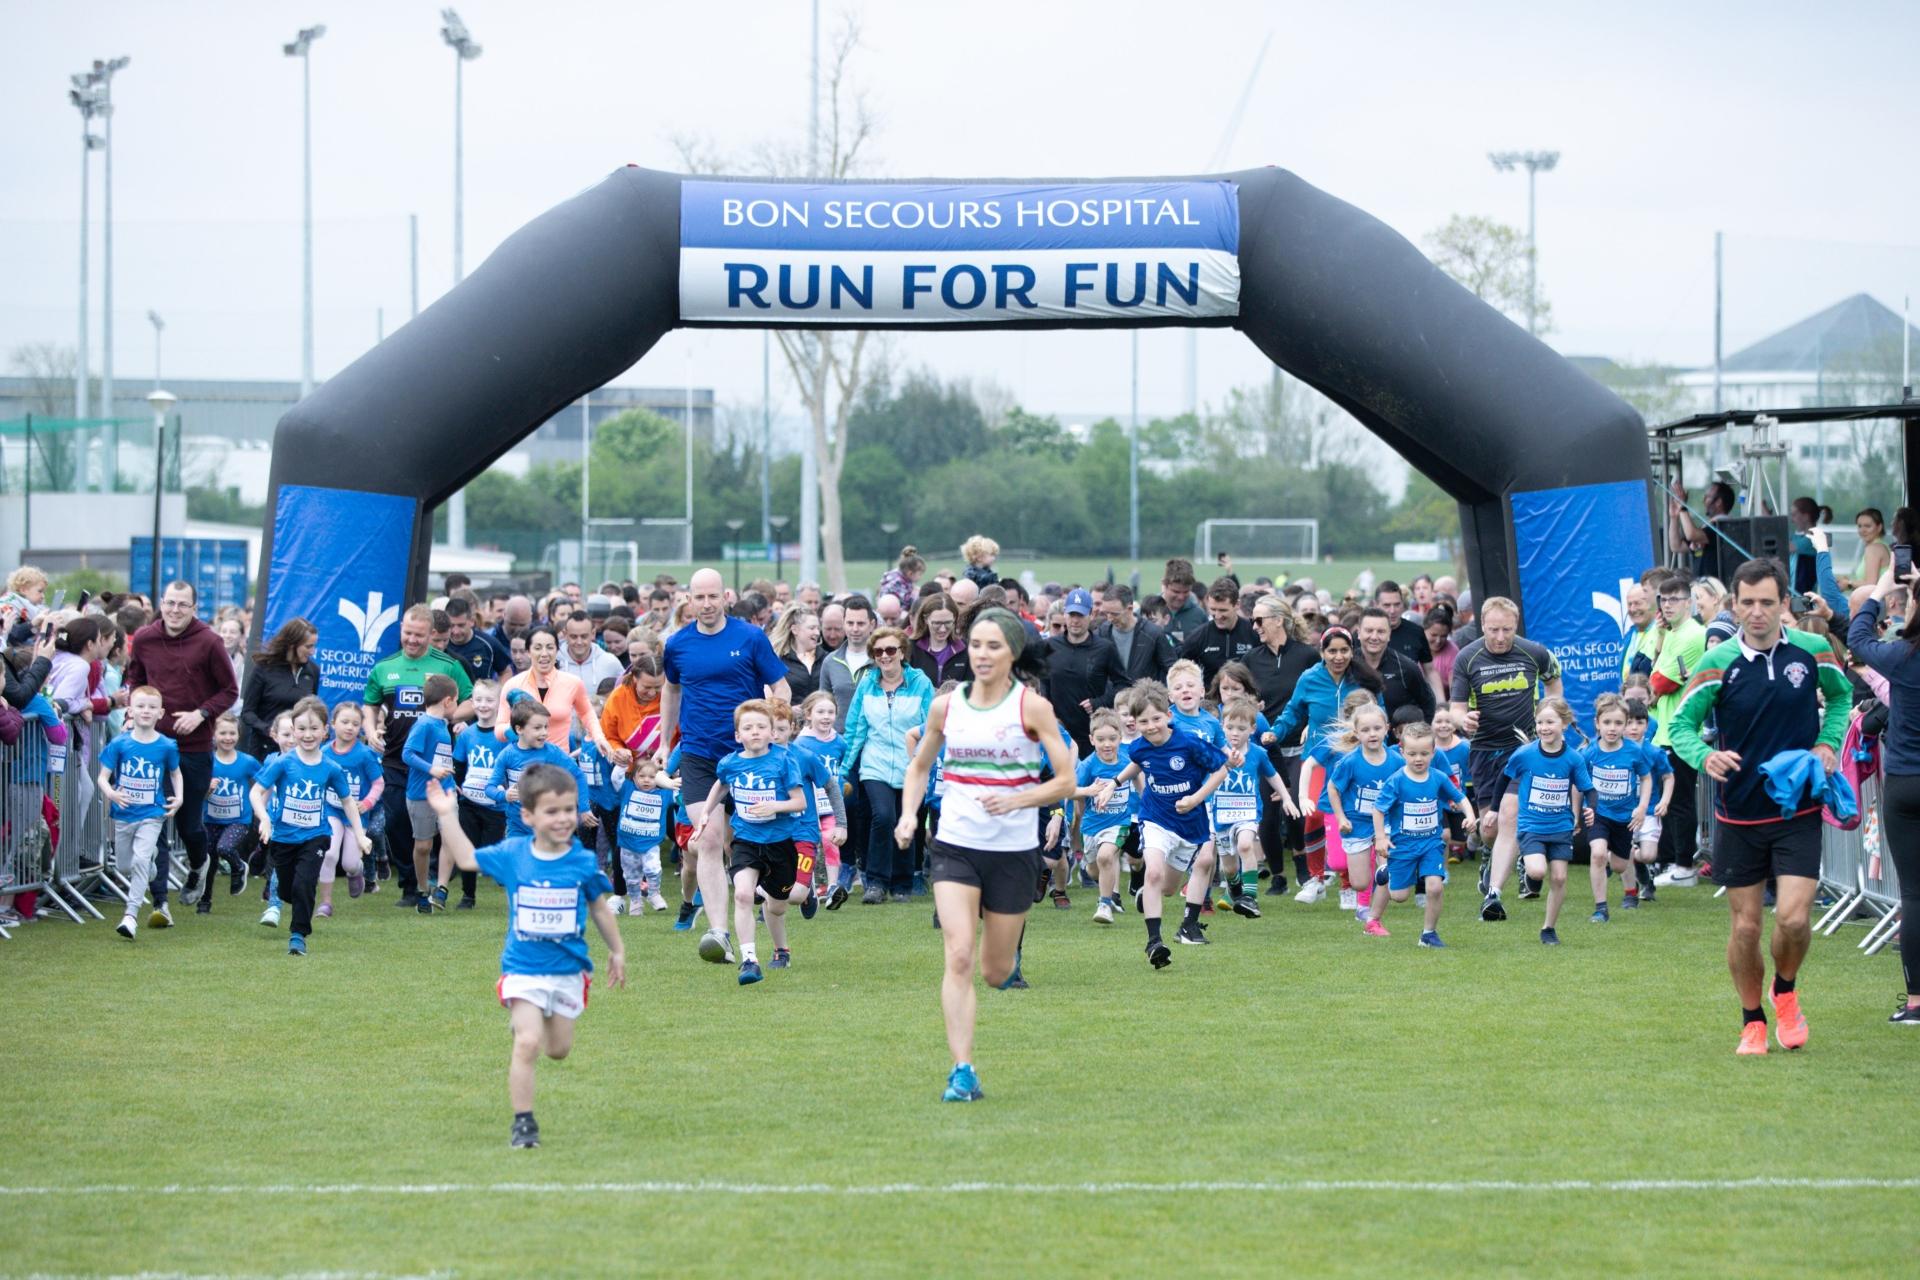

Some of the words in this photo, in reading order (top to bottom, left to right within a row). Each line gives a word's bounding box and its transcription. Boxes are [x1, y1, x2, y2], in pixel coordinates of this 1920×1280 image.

[723, 200, 809, 228] BON
[823, 200, 1001, 229] SECOURS
[1018, 199, 1200, 227] HOSPITAL
[724, 263, 871, 310] RUN
[902, 263, 1038, 310] FOR
[1064, 262, 1199, 308] FUN
[1554, 645, 1580, 658] BON
[1585, 642, 1624, 656] SECOU
[321, 649, 375, 665] SECOURS
[1559, 659, 1583, 671] ITAL
[1587, 656, 1620, 669] LIME
[1579, 673, 1588, 682] at
[1591, 670, 1618, 681] Barrin
[402, 691, 421, 702] kn
[1156, 781, 1191, 795] GAZPROM
[1600, 780, 1619, 789] 2277
[1540, 792, 1560, 801] 2080
[636, 805, 654, 814] 2090
[293, 812, 312, 822] 1544
[1415, 816, 1432, 825] 1411
[532, 912, 563, 924] 1399
